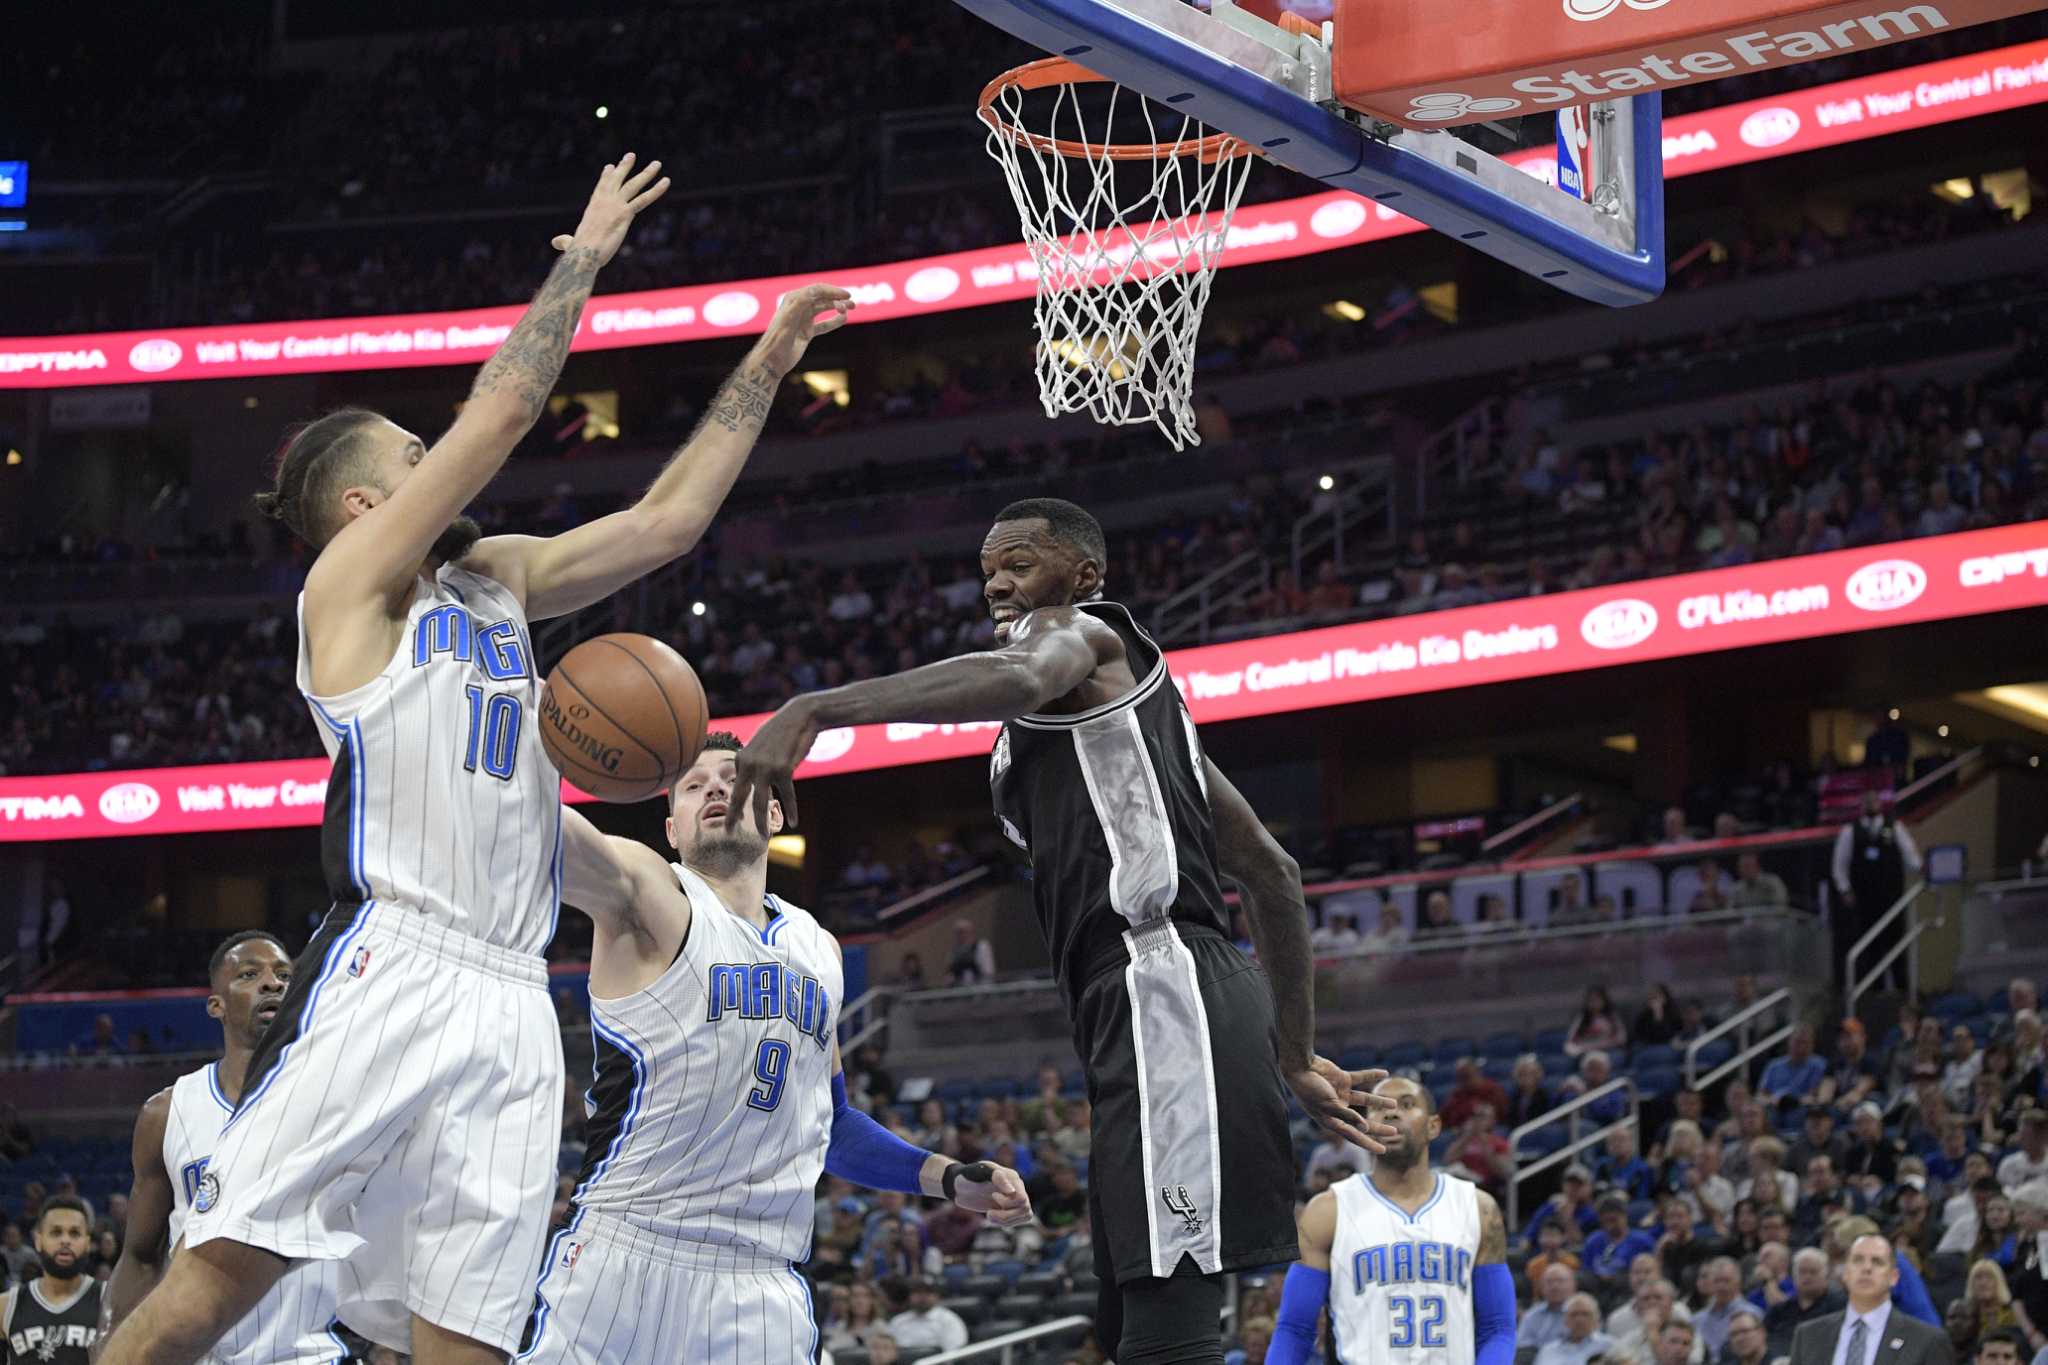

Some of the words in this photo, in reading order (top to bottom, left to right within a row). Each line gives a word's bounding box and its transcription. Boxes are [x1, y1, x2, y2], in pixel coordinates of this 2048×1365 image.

[1816, 100, 1862, 127] Visit
[1865, 91, 1913, 116] Your
[1915, 70, 1991, 107] Central
[1560, 165, 1580, 192] NBA
[196, 340, 237, 363] Visit
[239, 339, 280, 360] Your
[283, 334, 349, 358] Central
[350, 329, 412, 355] Florida
[413, 328, 445, 350] Kia
[1959, 547, 2048, 588] OPT
[1188, 669, 1242, 700] Your
[1244, 651, 1332, 692] Central
[1334, 641, 1417, 679] Florida
[1418, 635, 1461, 667] Kia
[1463, 624, 1559, 661] Dealers
[464, 683, 522, 781] 10
[177, 783, 225, 813] Visit
[226, 783, 278, 809] Your
[747, 1038, 792, 1113] 9
[1352, 1241, 1471, 1297] MAGIC
[1388, 1295, 1448, 1349] 32
